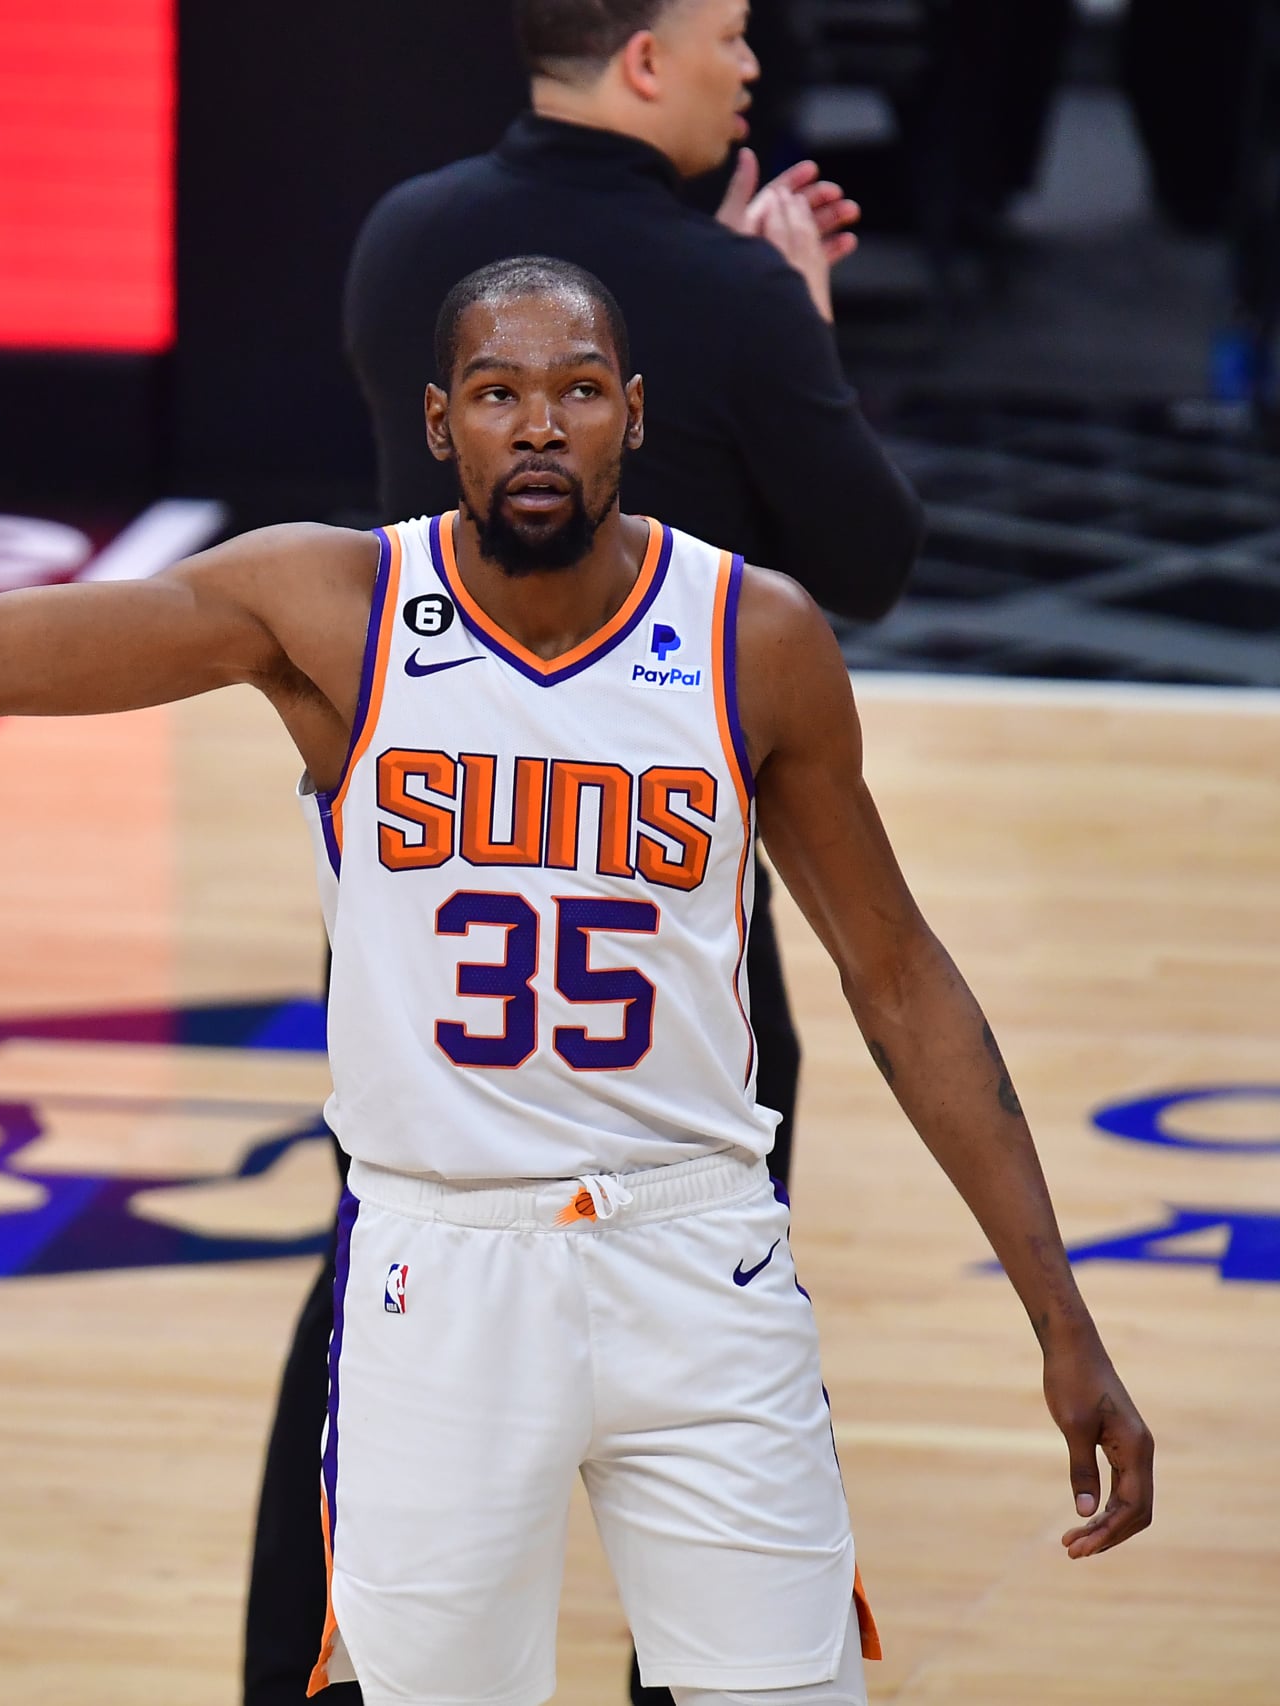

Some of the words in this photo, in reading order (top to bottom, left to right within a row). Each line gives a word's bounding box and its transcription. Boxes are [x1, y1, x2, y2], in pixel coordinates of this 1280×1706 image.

[415, 599, 442, 632] 6
[632, 664, 701, 686] PayPal
[376, 747, 718, 891] SUNS
[434, 889, 661, 1072] 35
